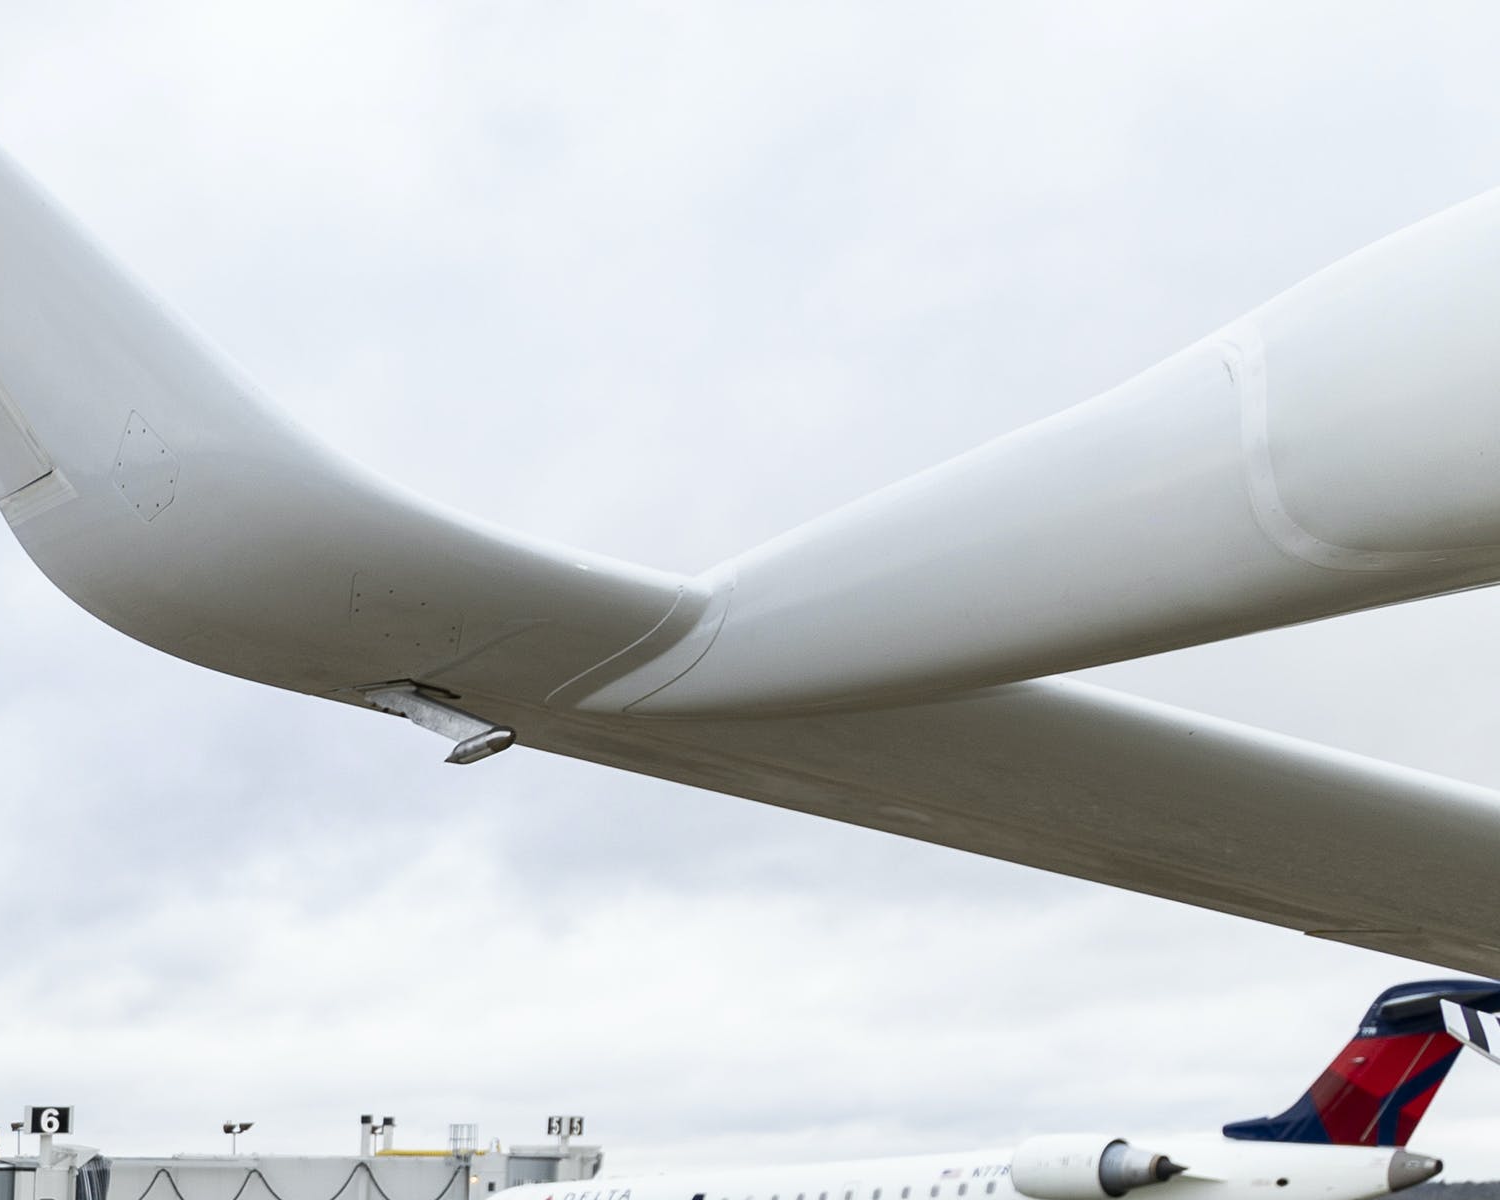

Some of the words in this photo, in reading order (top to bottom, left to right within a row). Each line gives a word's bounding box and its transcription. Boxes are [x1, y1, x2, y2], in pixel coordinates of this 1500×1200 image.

[40, 1108, 60, 1133] 6
[551, 1117, 560, 1135] 5
[572, 1117, 581, 1135] 5
